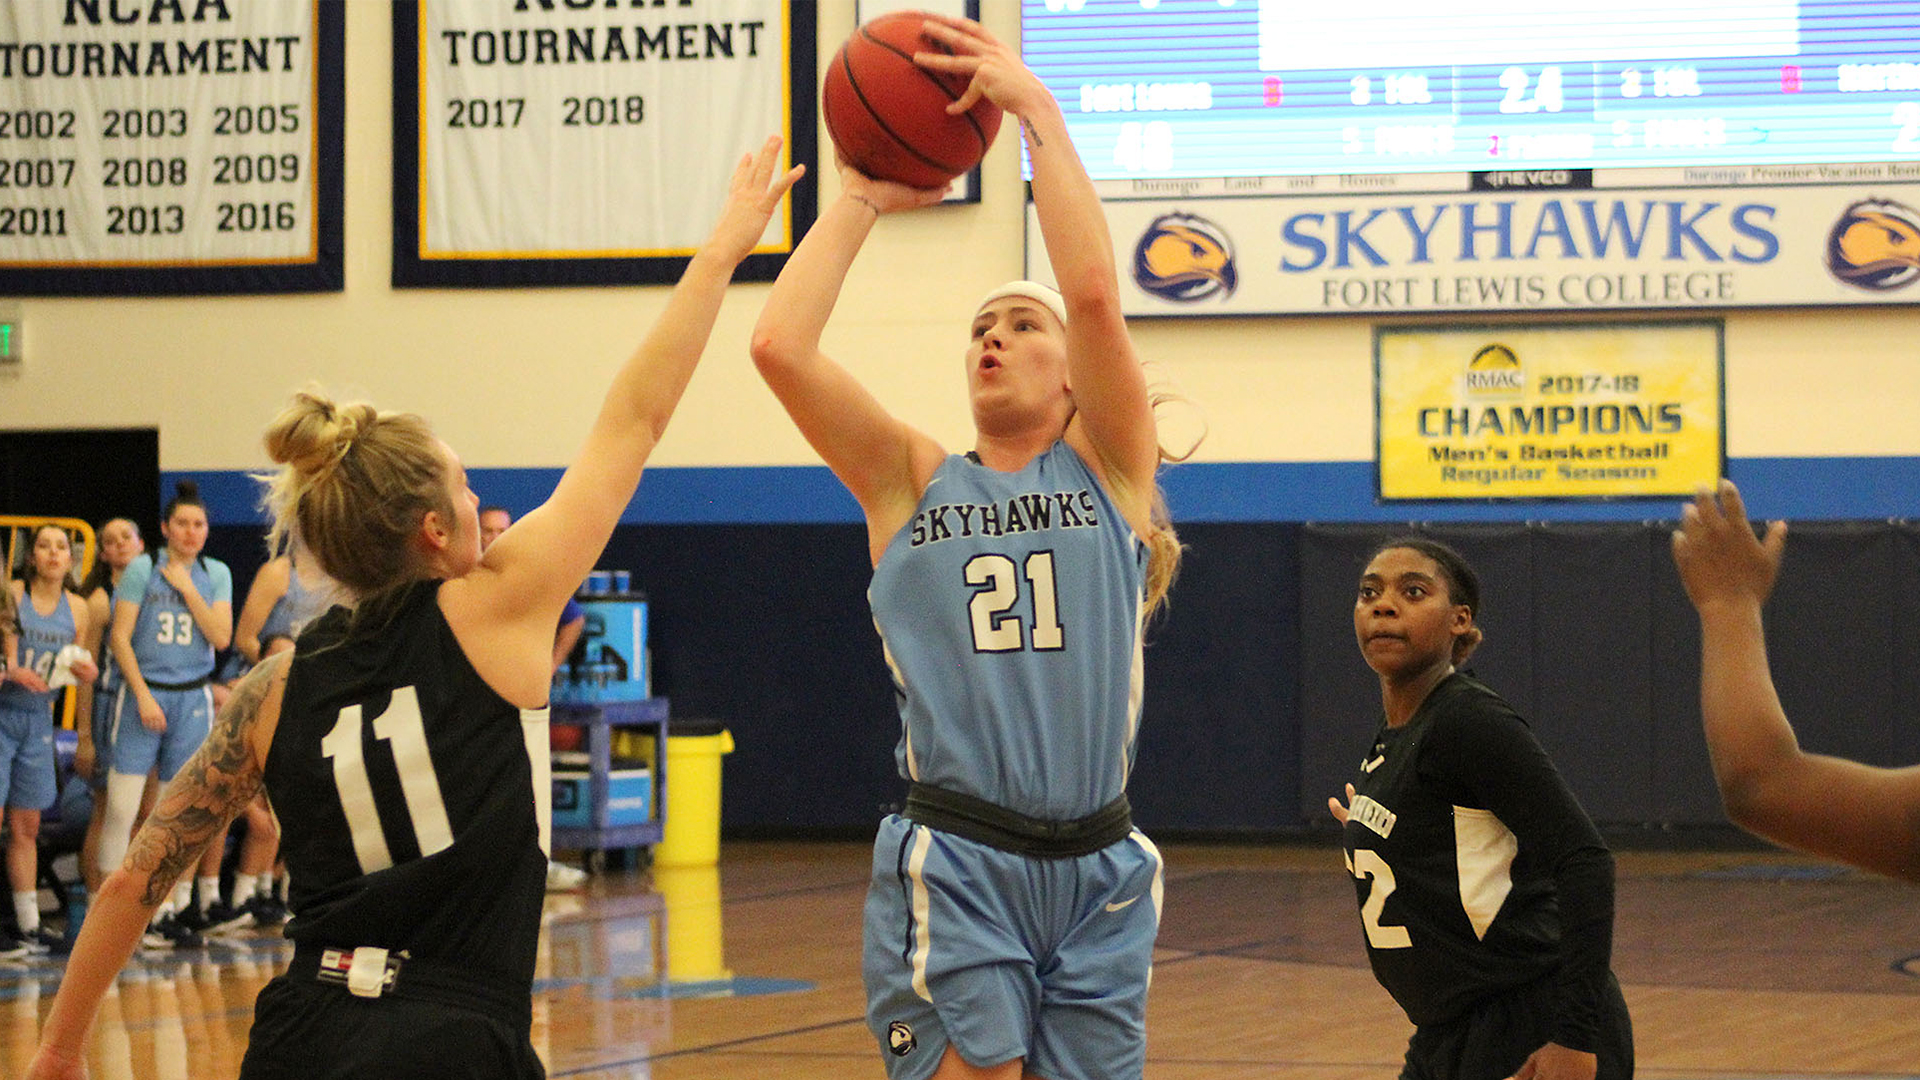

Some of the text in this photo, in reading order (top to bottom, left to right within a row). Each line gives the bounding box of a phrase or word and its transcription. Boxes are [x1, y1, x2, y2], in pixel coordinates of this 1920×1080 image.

[0, 36, 300, 78] TOURNAMENT
[442, 21, 765, 66] TOURNAMENT
[0, 104, 299, 139] 2002 2003 2005
[447, 96, 645, 128] 2017 2018
[0, 154, 299, 188] 2007 2008 2009
[0, 202, 296, 236] 2011 2013 2016
[1280, 202, 1779, 273] SKYHAWKS
[1321, 271, 1736, 307] FORT LEWIS COLLEGE
[1466, 371, 1522, 389] RMAC
[1539, 374, 1639, 394] 2017-18
[1418, 403, 1682, 437] CHAMPIONS
[1427, 442, 1669, 464] Men's Basketball
[1440, 463, 1657, 485] Regular Season
[909, 489, 1099, 549] SKYHAWKS
[962, 549, 1066, 654] 21
[156, 611, 194, 646] 33
[321, 685, 455, 876] 11
[1343, 847, 1414, 949] 2
